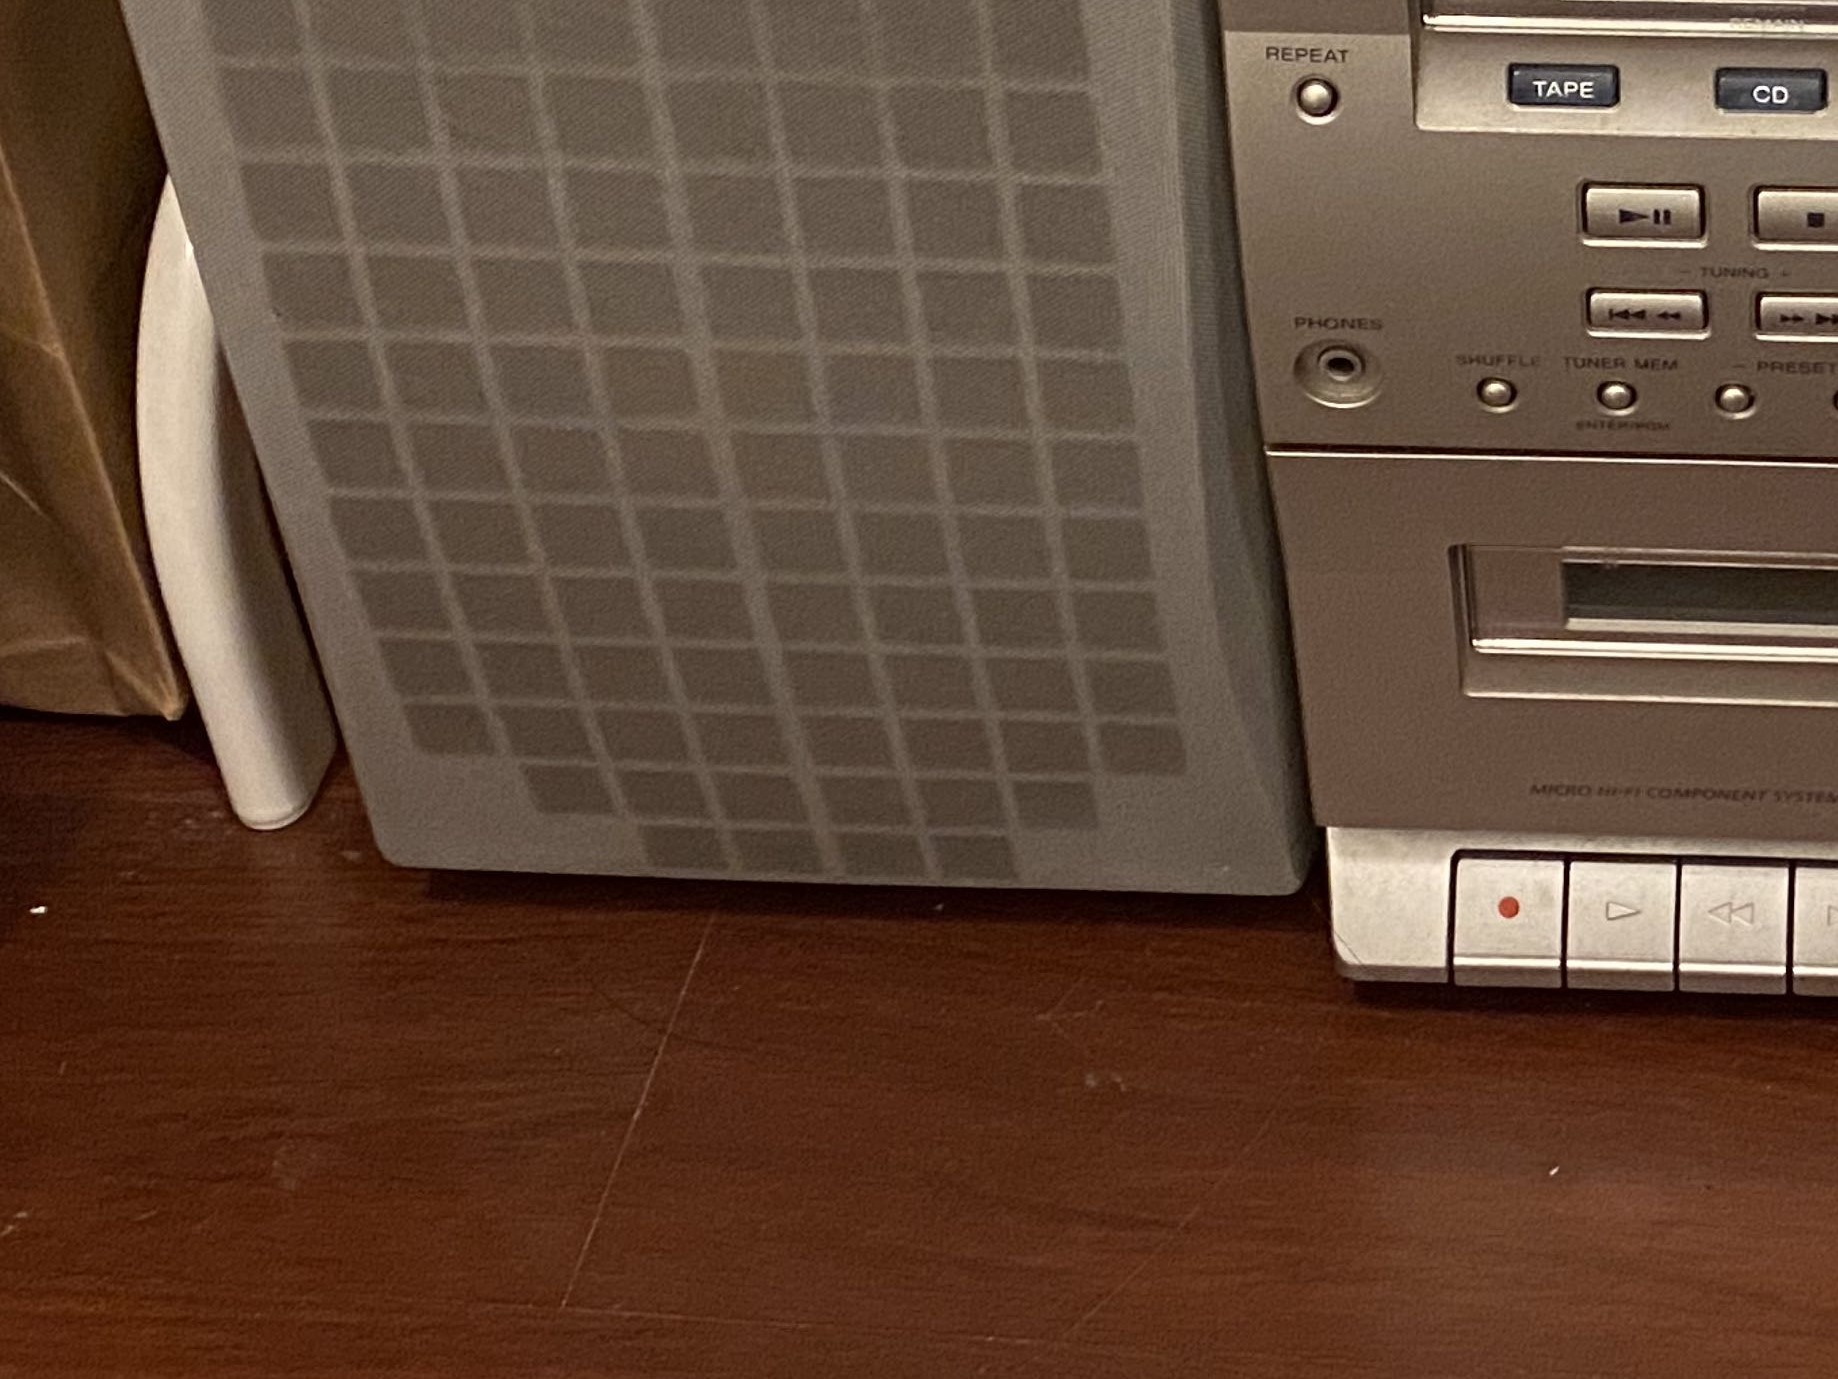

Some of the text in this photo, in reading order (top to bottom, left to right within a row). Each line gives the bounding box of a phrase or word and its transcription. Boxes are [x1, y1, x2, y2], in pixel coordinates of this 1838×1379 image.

[1265, 45, 1349, 64] REPEAT
[1532, 79, 1595, 100] TAPE
[1752, 84, 1790, 105] CD
[1699, 265, 1770, 280] TUNING
[1293, 315, 1384, 332] PHONES
[1455, 353, 1542, 369] SHUFFLE
[1563, 356, 1679, 372] TUNER MEM
[1756, 360, 1838, 375] PRESET
[1529, 783, 1593, 798] MICRO
[1647, 786, 1769, 803] COMPONENT
